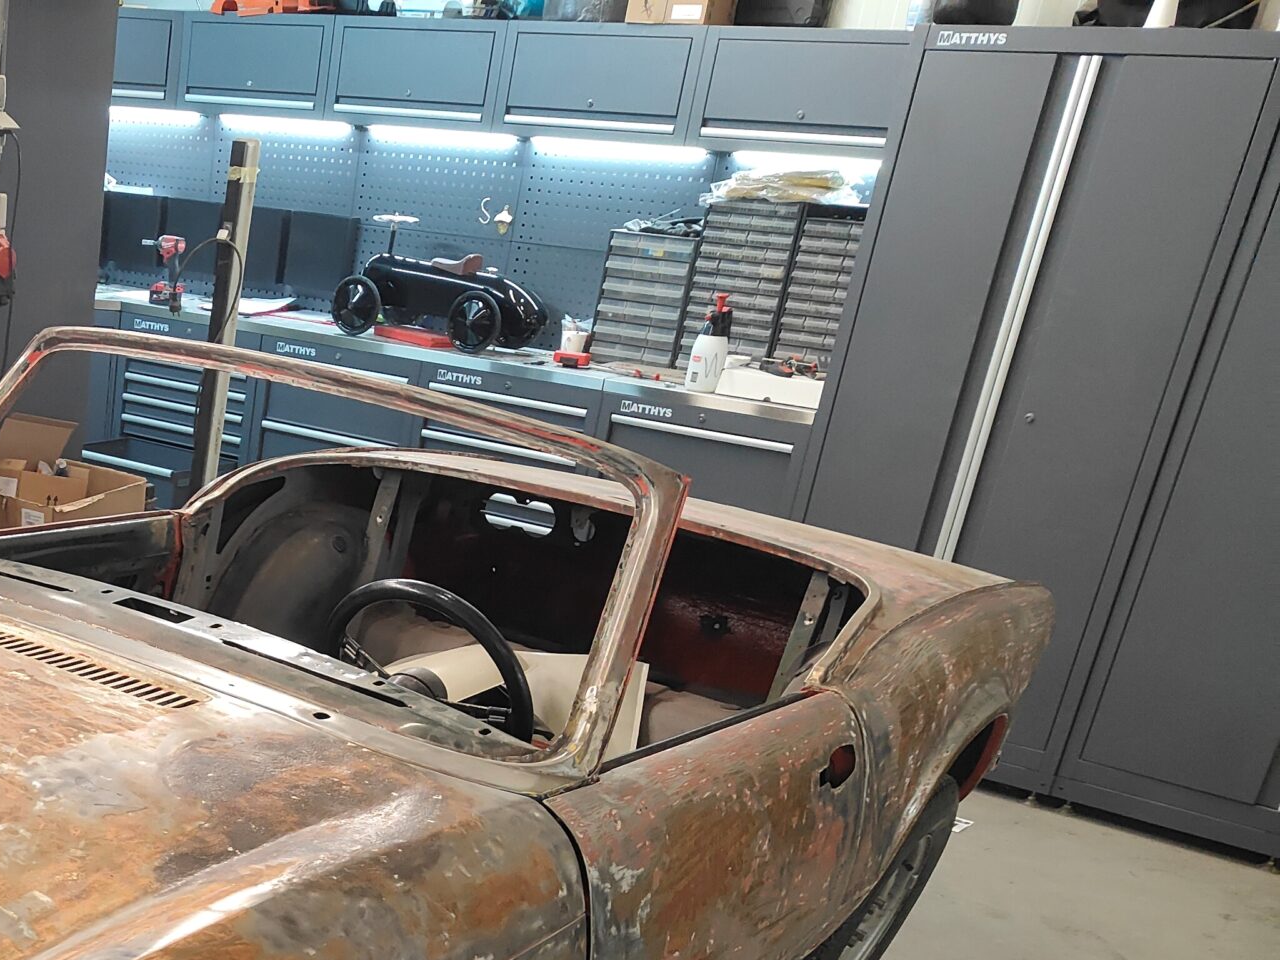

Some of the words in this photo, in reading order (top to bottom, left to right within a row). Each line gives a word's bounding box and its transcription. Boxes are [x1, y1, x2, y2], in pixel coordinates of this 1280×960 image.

[937, 30, 1008, 46] MATTHYS
[133, 318, 170, 333] MATTHYS
[276, 341, 317, 357] MATTHYS
[437, 369, 483, 385] MATTHYS
[620, 400, 673, 418] MATTHYS
